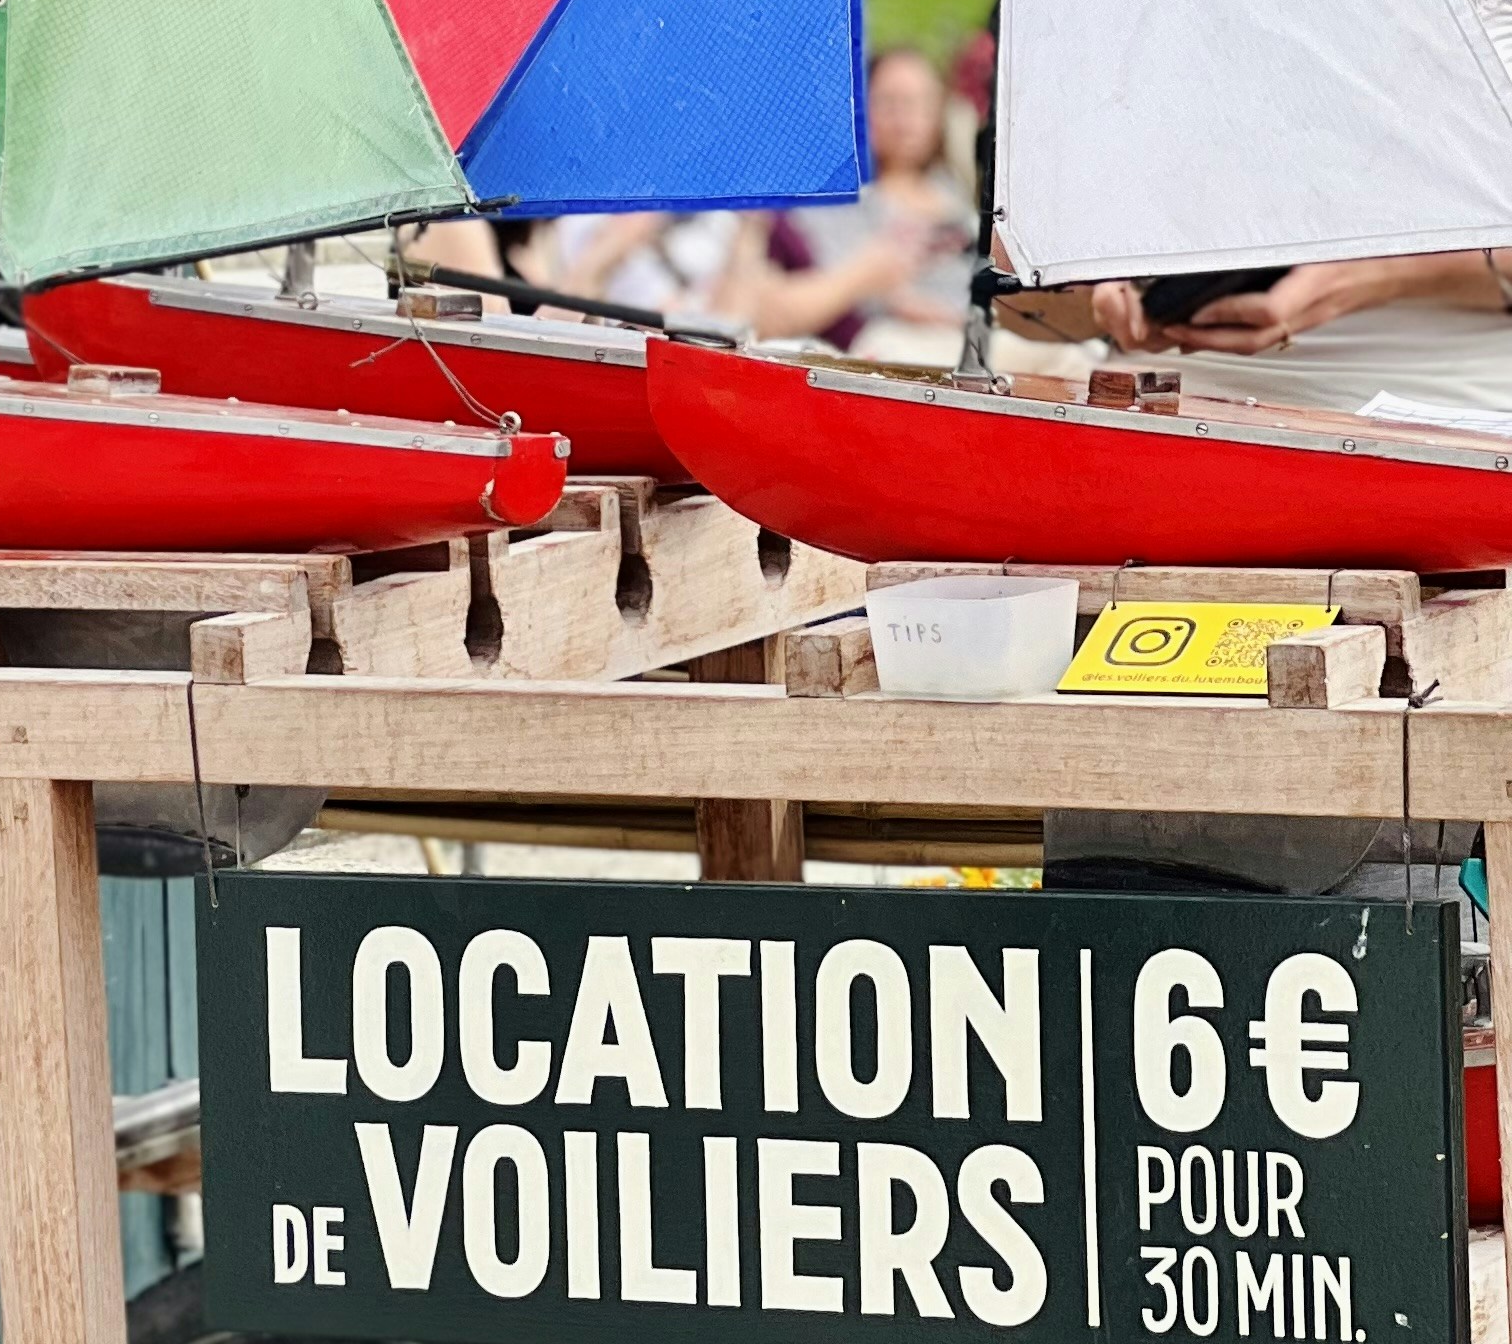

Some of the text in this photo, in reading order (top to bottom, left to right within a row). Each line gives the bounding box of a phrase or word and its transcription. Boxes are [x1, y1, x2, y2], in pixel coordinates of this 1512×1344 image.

[265, 925, 1043, 1122] LOCATION
[272, 1122, 1048, 1327] DE VOILIERS
[1137, 1145, 1306, 1238] POUR
[1140, 1246, 1368, 1343] 30 MIN.
